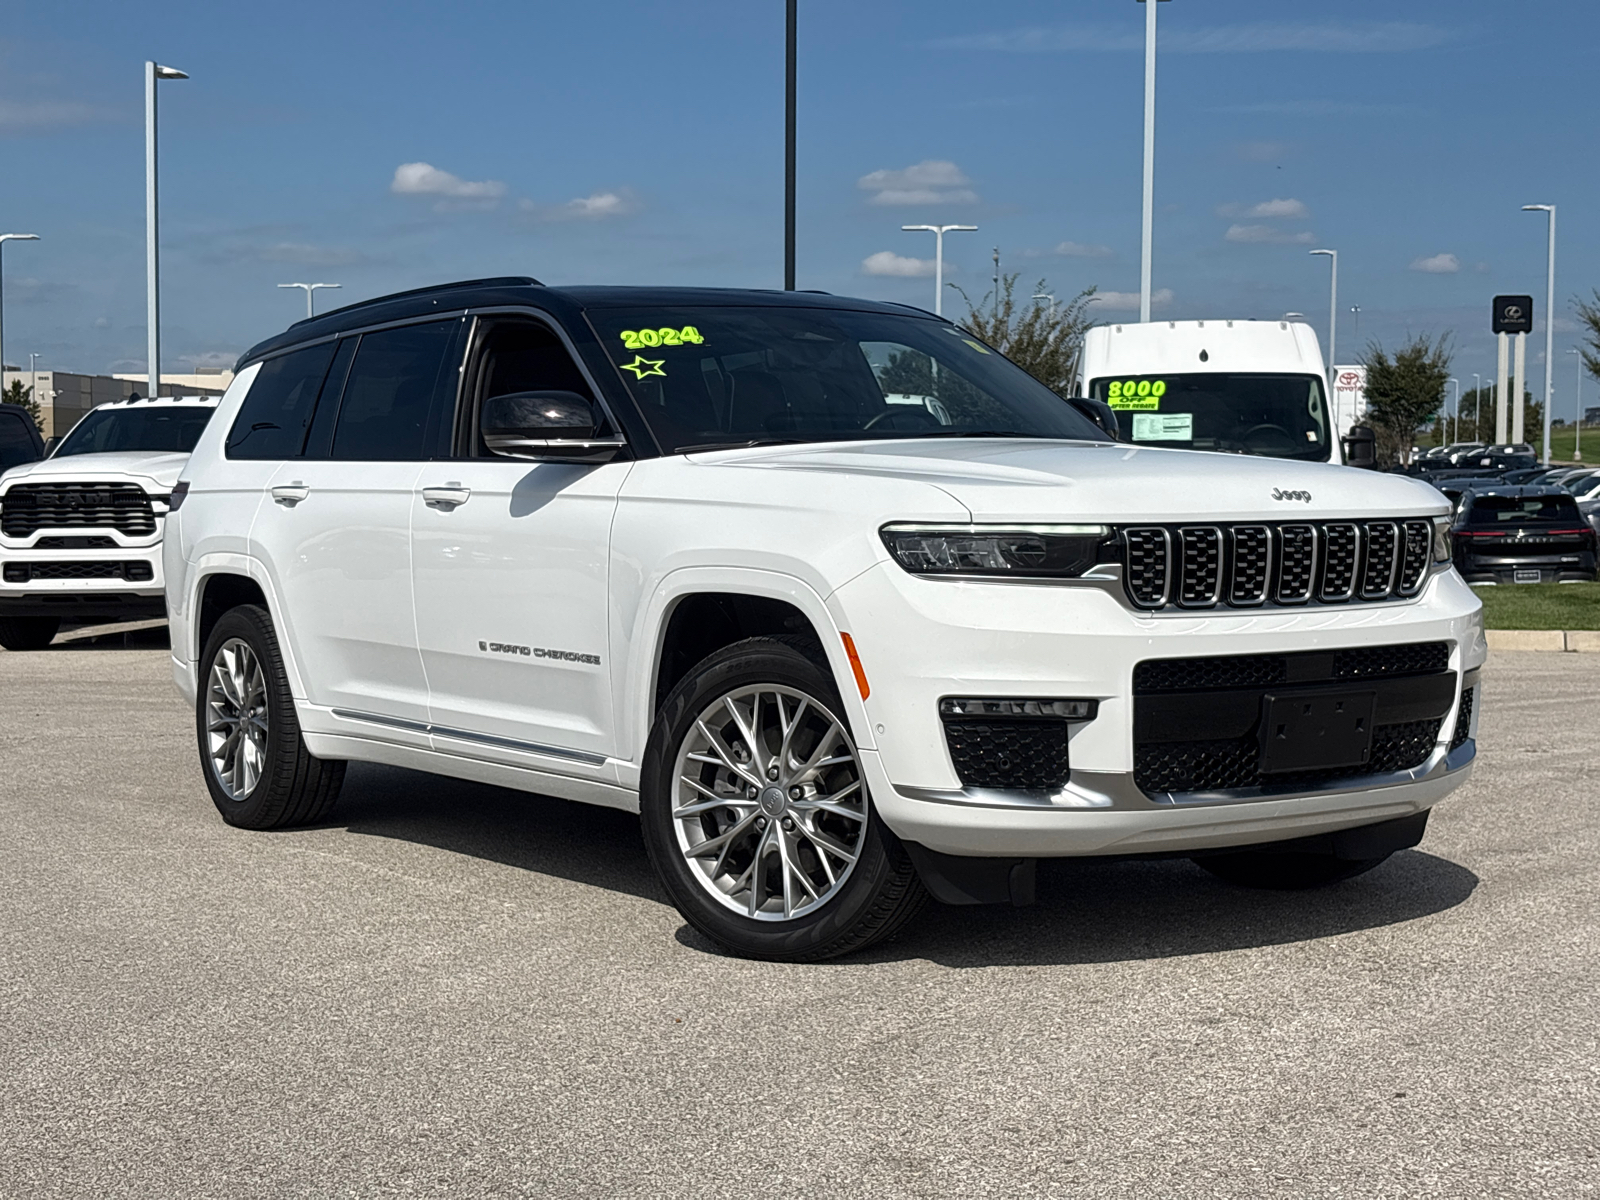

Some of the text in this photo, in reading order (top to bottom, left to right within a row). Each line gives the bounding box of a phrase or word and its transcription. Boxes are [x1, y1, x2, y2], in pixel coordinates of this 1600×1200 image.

[620, 326, 704, 349] 2024
[1108, 380, 1166, 397] 8000
[36, 492, 111, 505] RAM
[1270, 487, 1312, 504] Jeep
[489, 642, 601, 665] GRAND CHEROKEE
